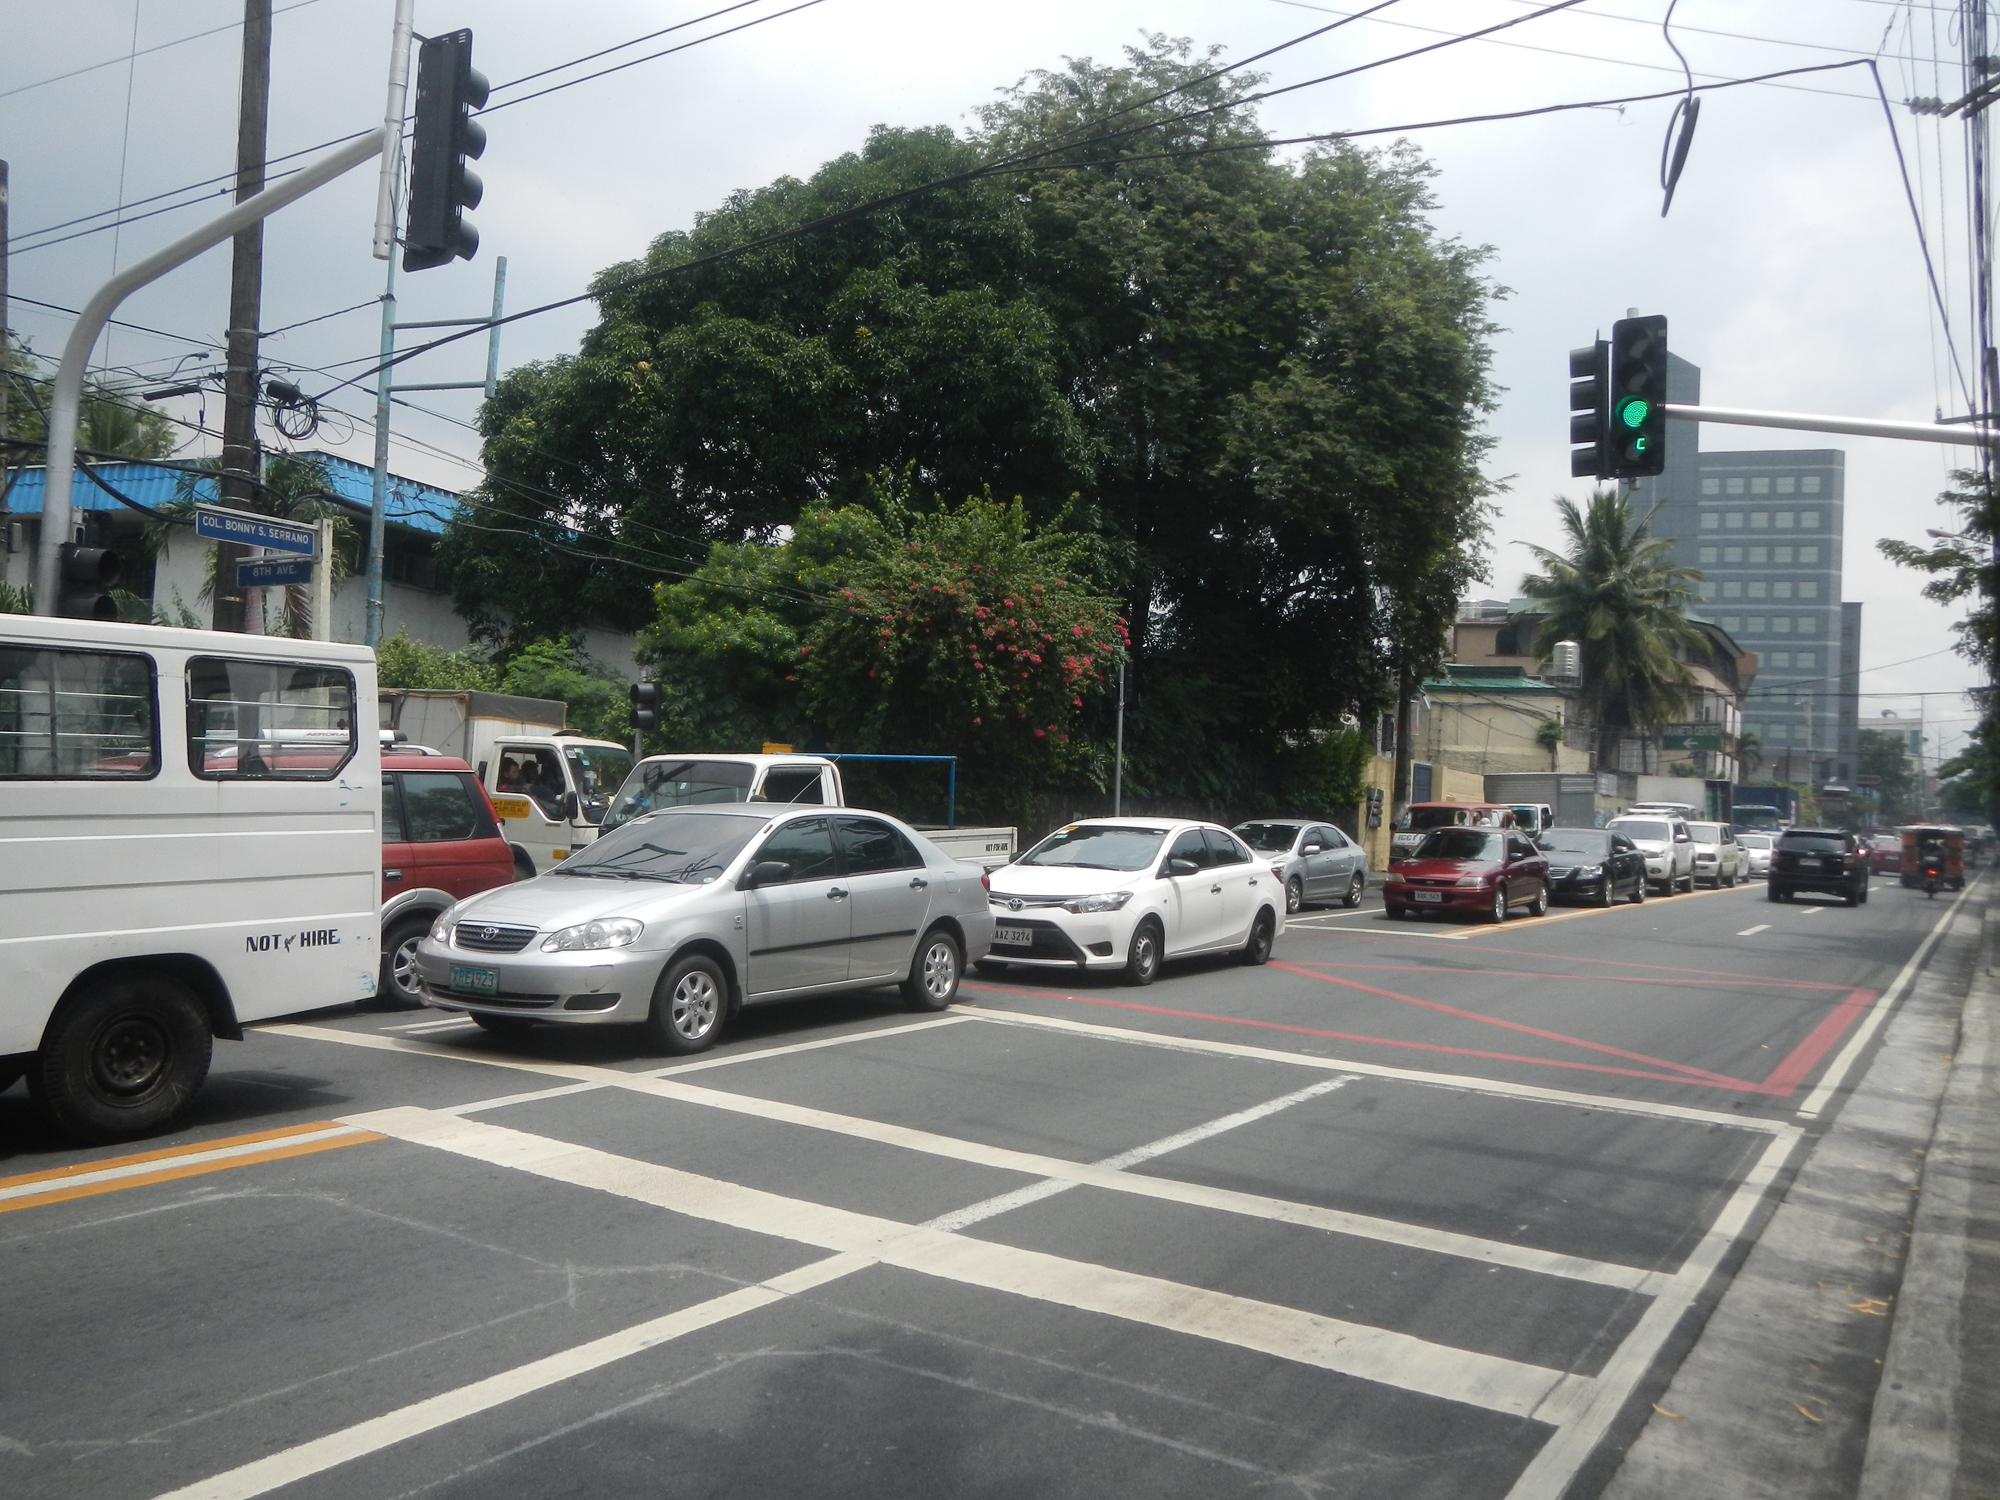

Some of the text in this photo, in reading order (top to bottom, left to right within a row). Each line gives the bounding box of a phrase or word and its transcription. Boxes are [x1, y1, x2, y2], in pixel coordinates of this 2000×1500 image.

[202, 515, 309, 545] COL. BONNY S. SERRANO
[252, 564, 297, 577] 8TH AVE.
[246, 934, 282, 953] NOT
[300, 929, 339, 948] HIRE
[994, 930, 1030, 941] AAZ 3274
[476, 970, 494, 987] 923
